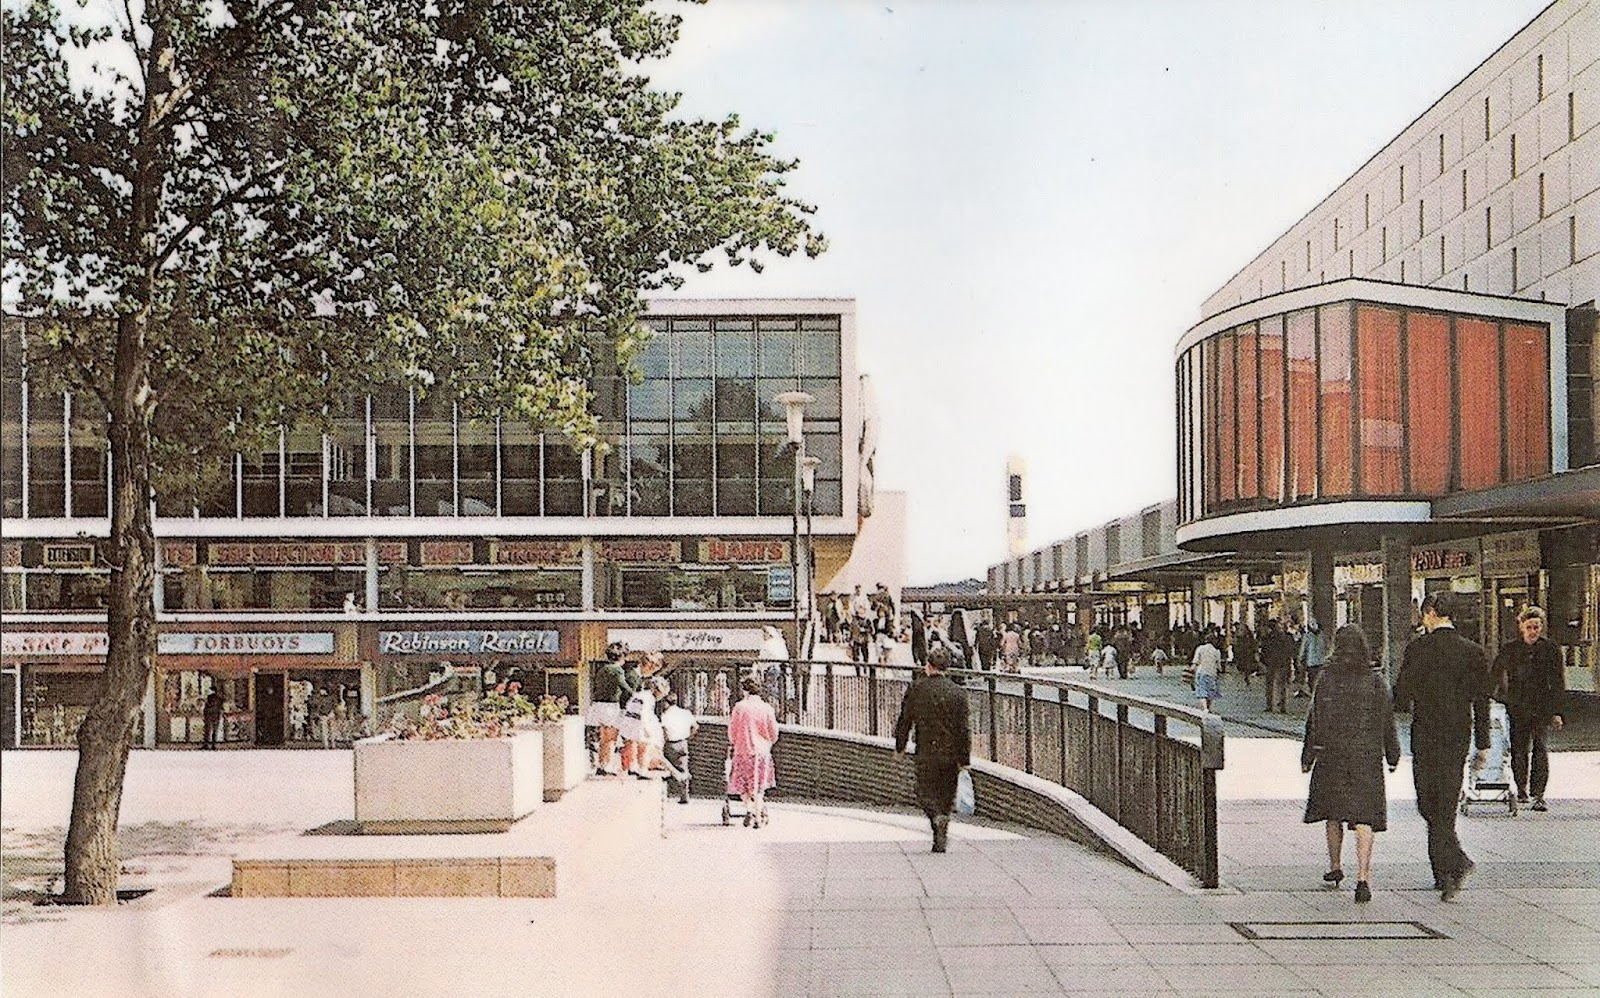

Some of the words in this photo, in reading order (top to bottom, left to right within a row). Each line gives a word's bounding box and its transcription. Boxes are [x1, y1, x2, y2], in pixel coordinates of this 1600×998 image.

[192, 636, 300, 650] FORBUOYS
[383, 631, 470, 653] Robinson
[480, 631, 551, 654] Rentals
